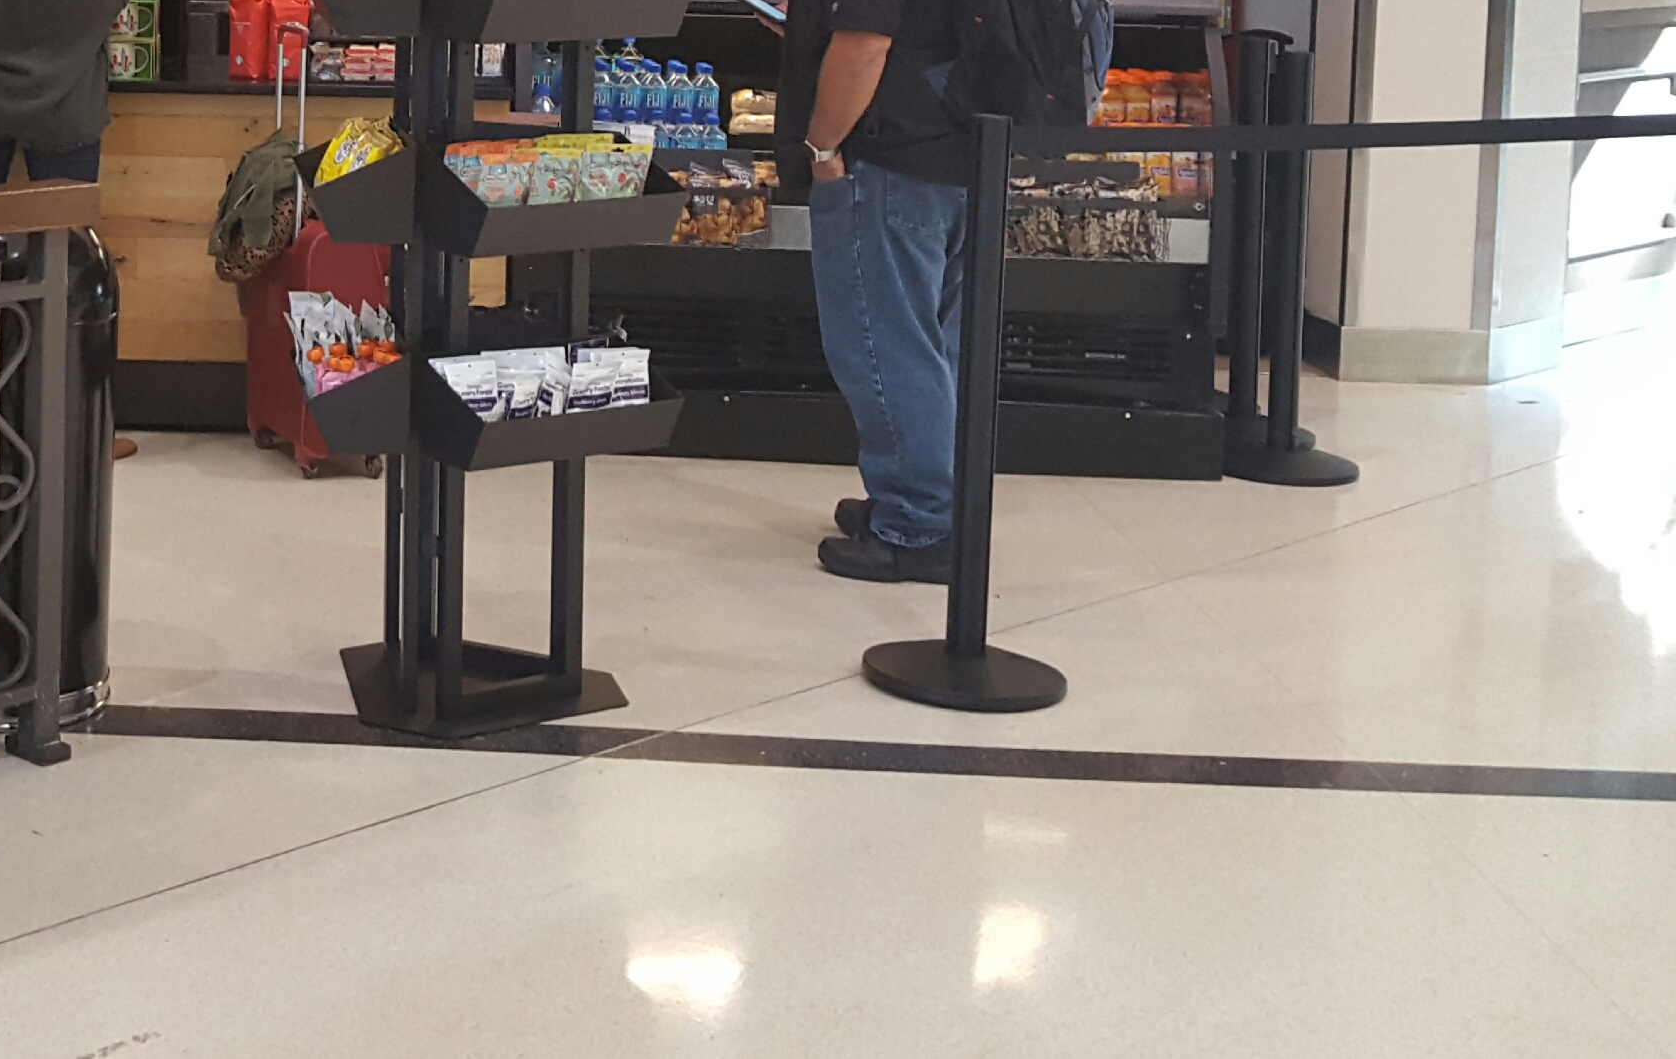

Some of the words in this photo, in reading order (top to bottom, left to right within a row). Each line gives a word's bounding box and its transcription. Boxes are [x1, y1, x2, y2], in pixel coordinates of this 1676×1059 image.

[593, 92, 612, 106] FIJI
[620, 93, 638, 108] FIJI
[646, 93, 665, 108] FIJI
[673, 93, 692, 109] FIJI
[698, 93, 718, 109] FIJI
